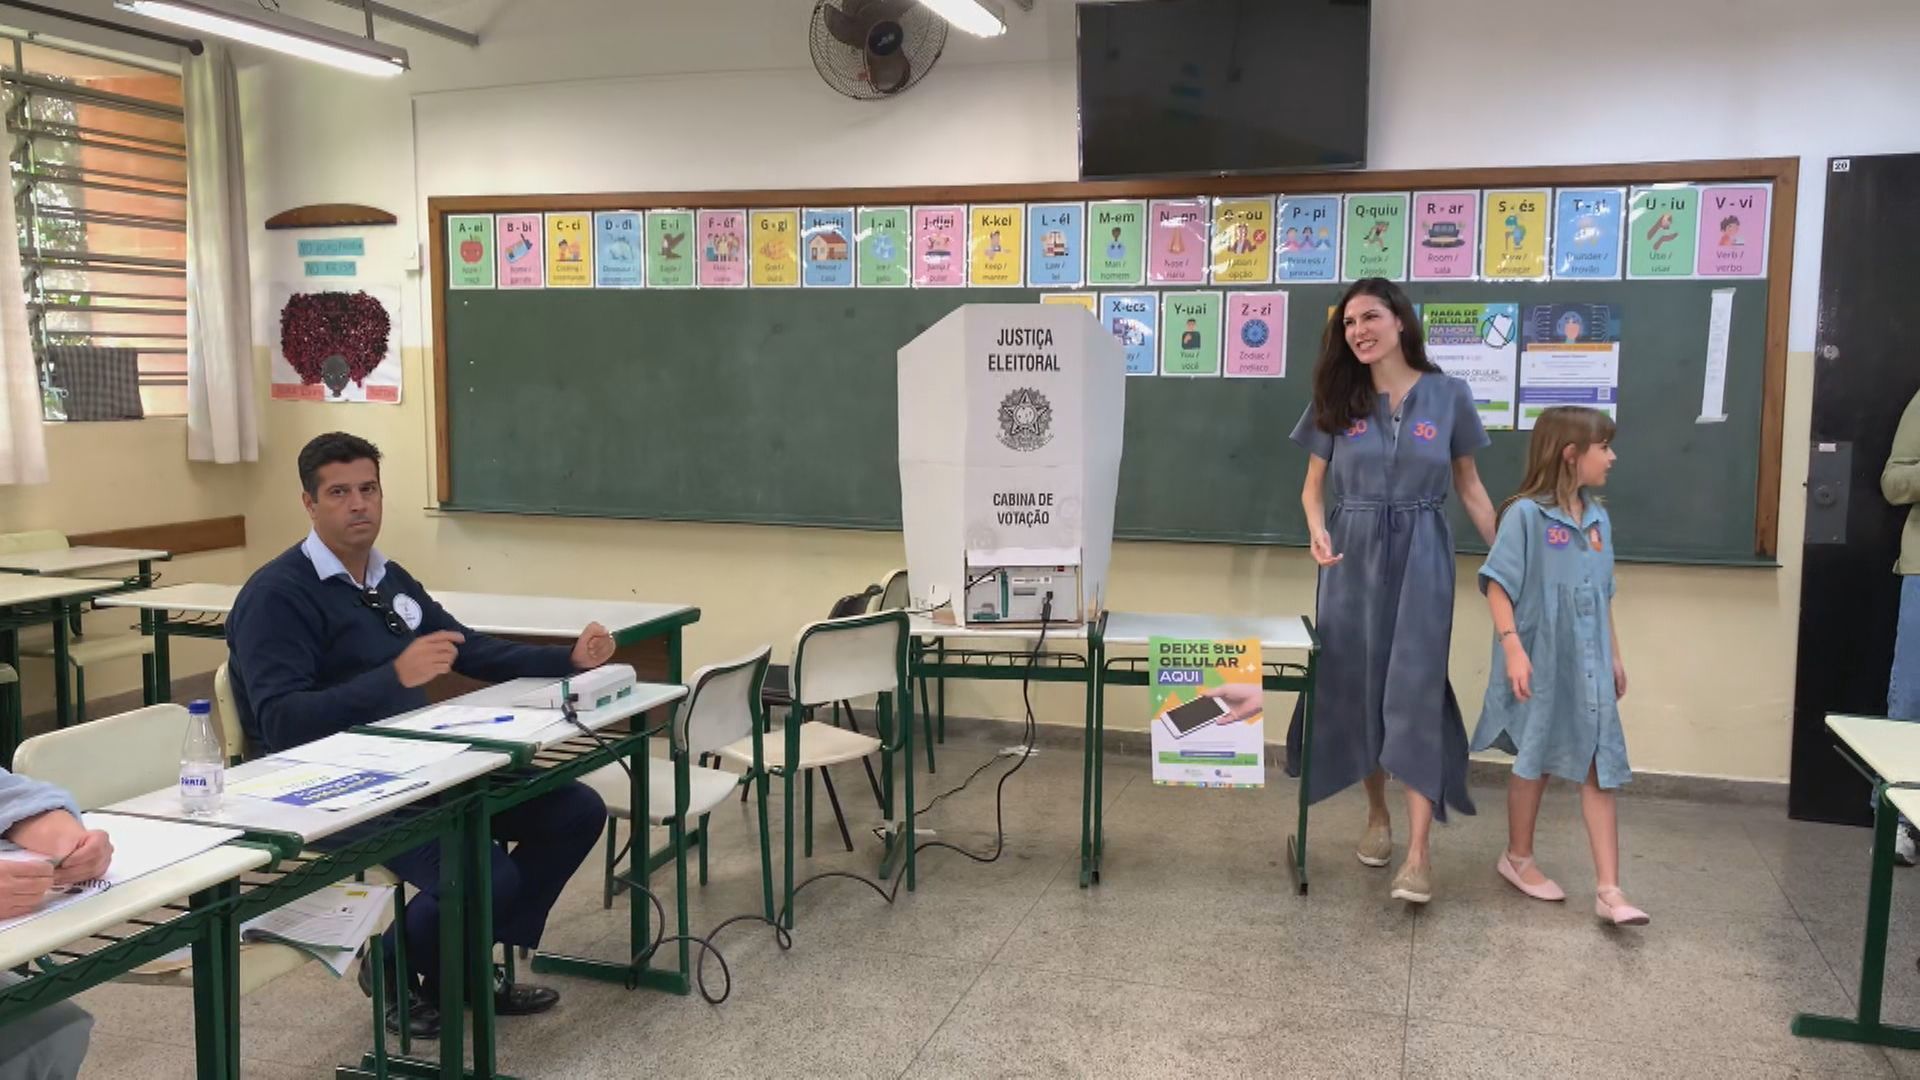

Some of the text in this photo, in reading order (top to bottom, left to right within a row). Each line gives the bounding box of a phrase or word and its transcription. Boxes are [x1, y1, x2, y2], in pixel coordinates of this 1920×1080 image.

[1834, 162, 1848, 170] 20
[1498, 201, 1507, 212] S
[1519, 199, 1535, 212] és
[1573, 199, 1583, 212] T
[1646, 198, 1656, 210] U
[1671, 197, 1685, 210] iu
[1716, 197, 1726, 209] V
[1739, 195, 1753, 209] vi
[1427, 203, 1436, 214] R
[1448, 203, 1464, 214] ar
[1160, 211, 1170, 222] N
[1293, 207, 1301, 218] P
[1313, 207, 1326, 222] pi
[556, 221, 564, 231] C
[572, 221, 581, 231] ci
[605, 220, 613, 230] D
[622, 219, 632, 230] di
[661, 219, 667, 230] E
[708, 218, 714, 229] F
[761, 219, 769, 230] G
[777, 219, 788, 231] gi
[885, 218, 896, 229] ai
[981, 214, 1012, 227] K-kei
[1042, 215, 1048, 226] L
[459, 223, 466, 232] A
[507, 223, 514, 232] B
[522, 222, 532, 232] bi
[1427, 253, 1453, 263] Room
[1241, 303, 1249, 316] Z
[1260, 303, 1272, 316] zi
[1464, 309, 1479, 317] DE
[1430, 327, 1474, 336] NA HORA
[997, 328, 1053, 350] JUSTIÇA
[1429, 336, 1443, 345] DE
[988, 354, 1061, 372] ELEITORAL
[1413, 422, 1437, 440] 30
[993, 493, 1054, 506] CABINA DE
[997, 509, 1050, 528] VOTAÇÃO
[1547, 528, 1569, 545] 30
[1160, 643, 1247, 654] DEIXE SEU
[1160, 657, 1239, 668] CELULAR
[1159, 671, 1200, 683] AQUI
